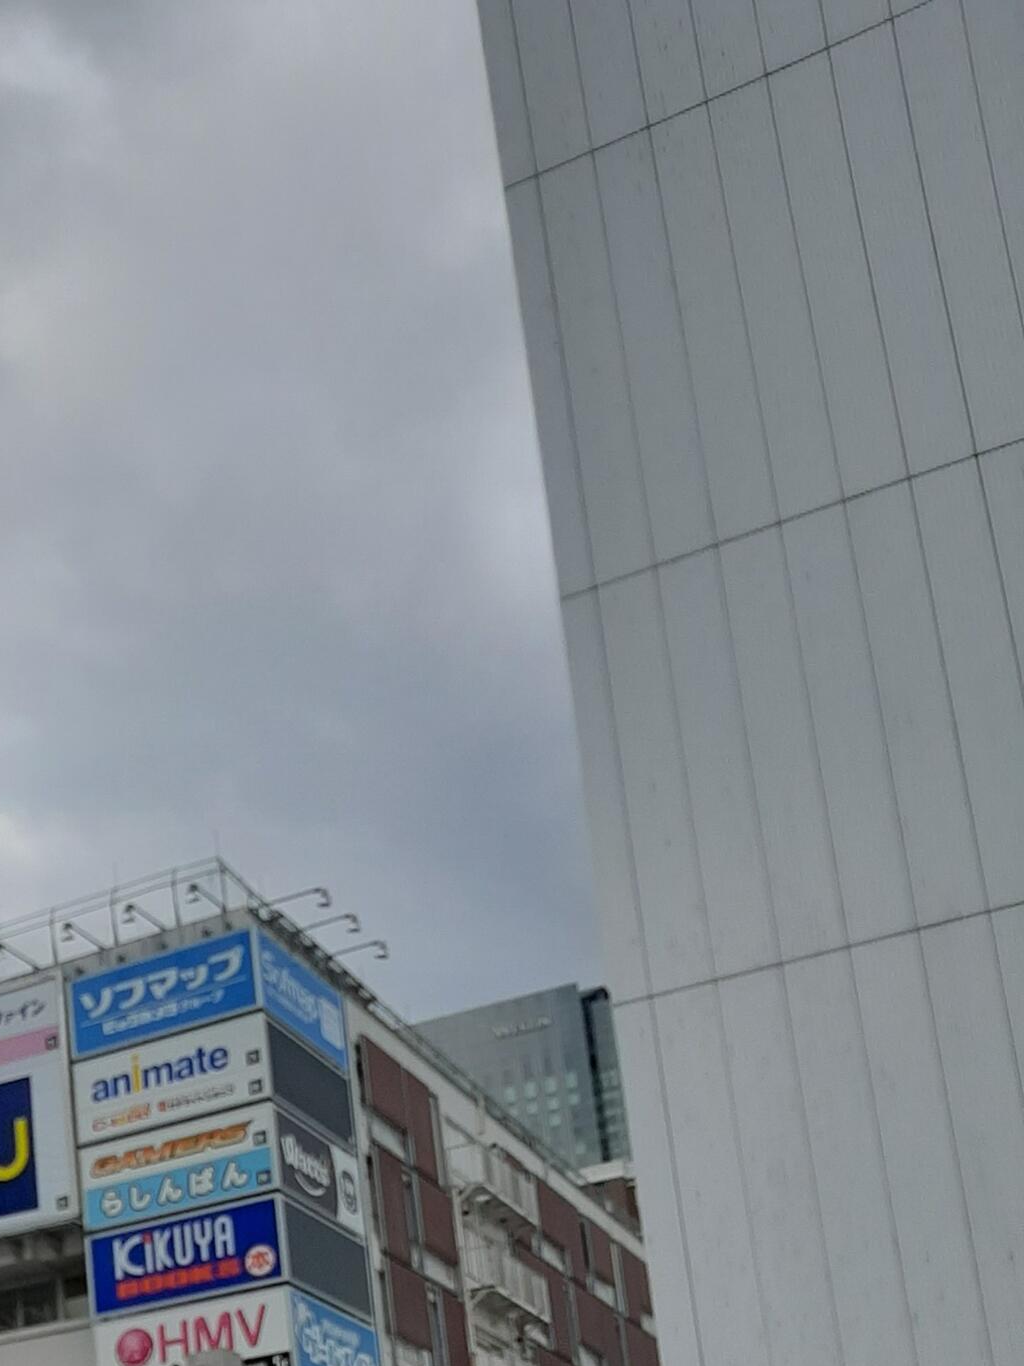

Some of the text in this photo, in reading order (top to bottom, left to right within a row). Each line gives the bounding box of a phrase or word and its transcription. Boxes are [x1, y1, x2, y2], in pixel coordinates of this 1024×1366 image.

[79, 944, 246, 1019] ソフマップ
[91, 1046, 229, 1102] animate
[99, 1161, 250, 1218] らしんばん
[157, 1304, 267, 1364] HMV
